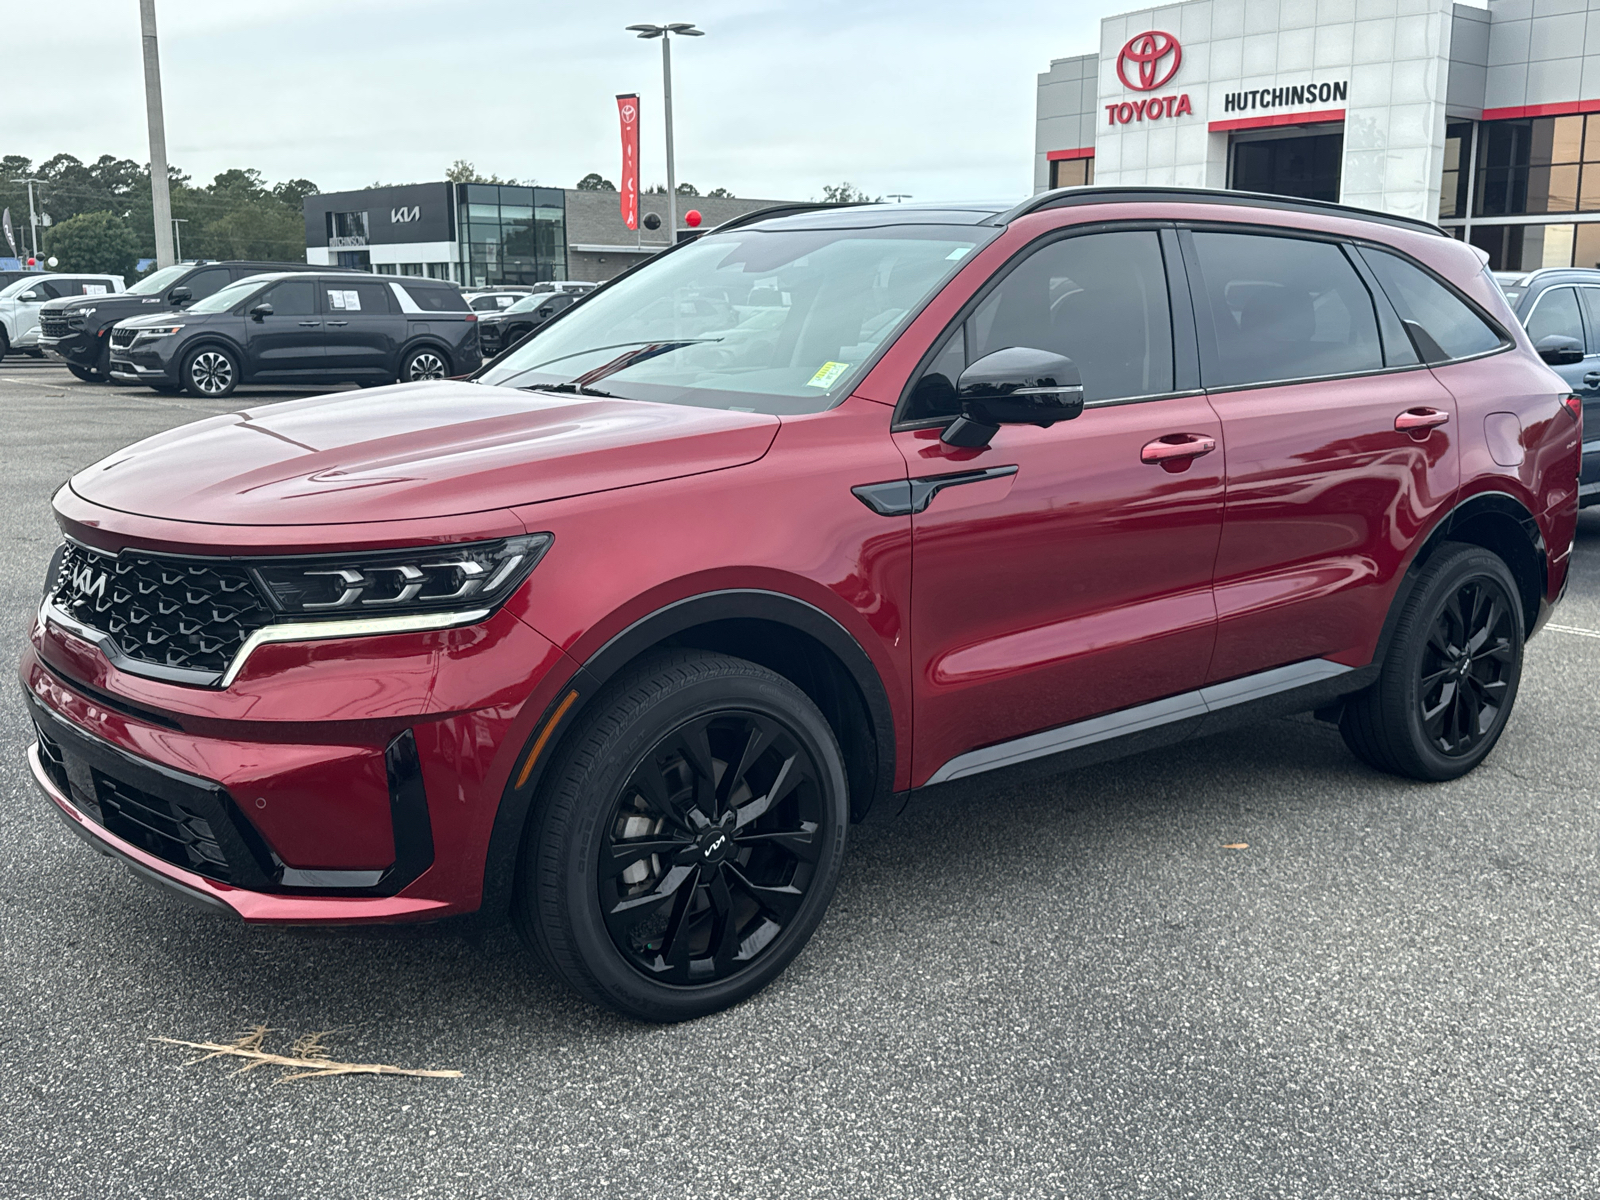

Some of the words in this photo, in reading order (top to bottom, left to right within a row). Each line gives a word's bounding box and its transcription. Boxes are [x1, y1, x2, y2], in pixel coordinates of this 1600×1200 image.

[1105, 93, 1192, 126] TOYOTA
[1224, 80, 1348, 112] HUTCHINSON
[391, 205, 420, 224] KIA
[72, 560, 108, 599] KIA
[704, 834, 726, 857] KIA
